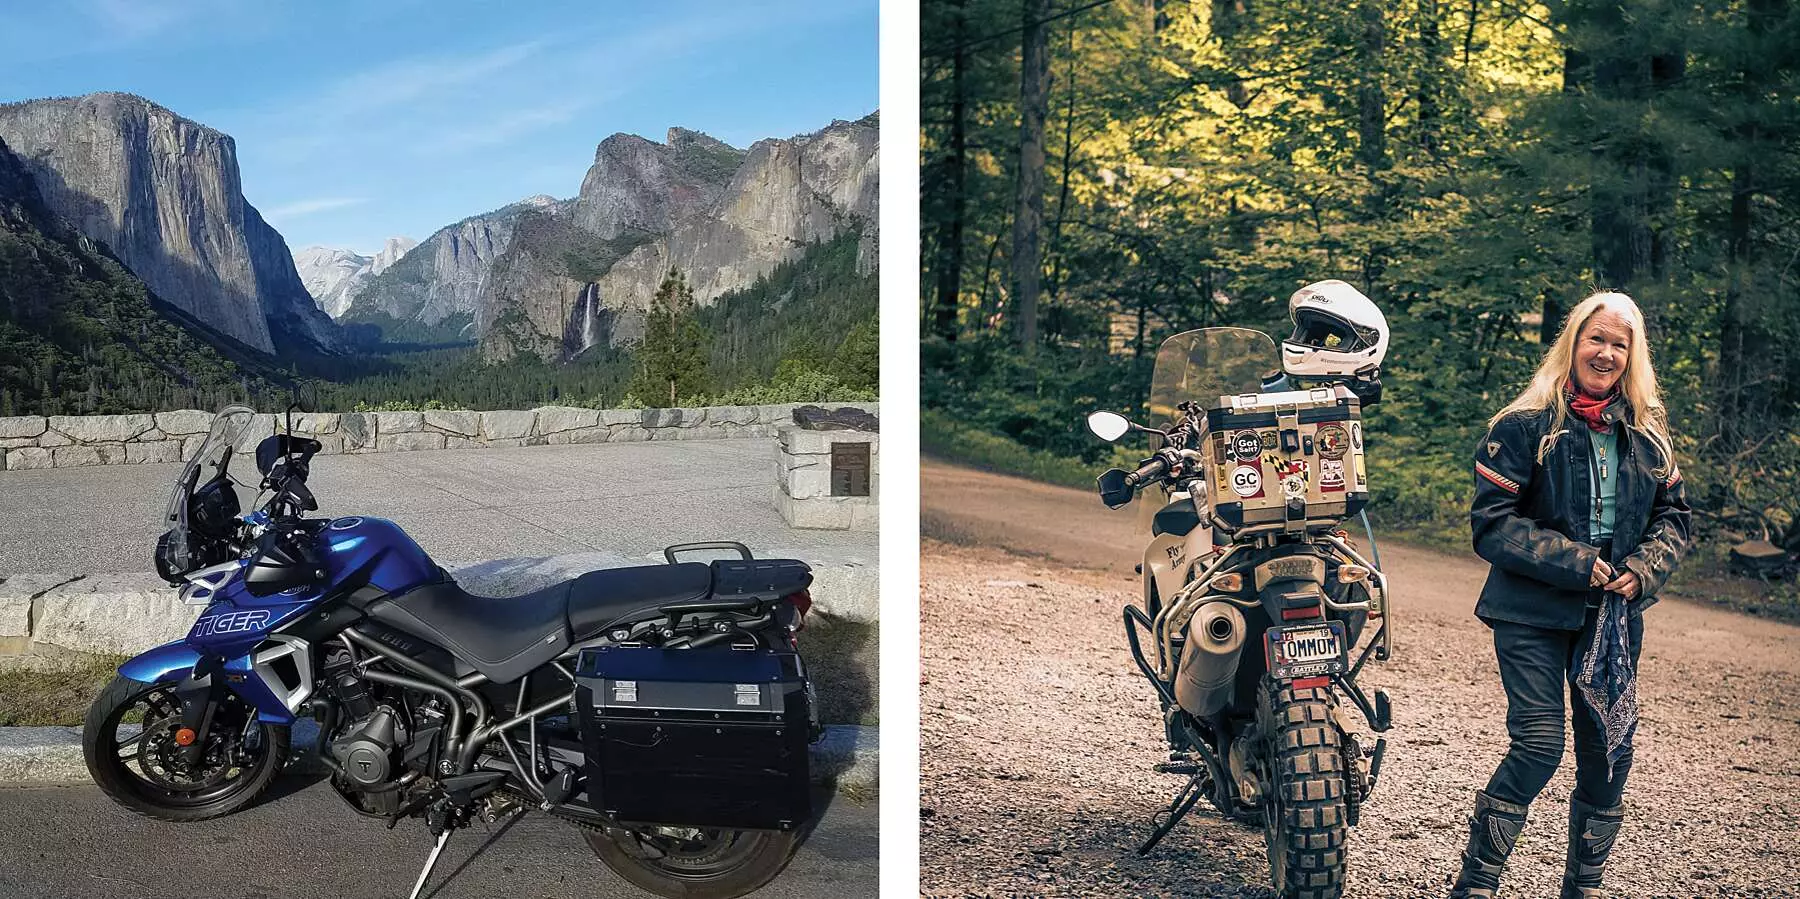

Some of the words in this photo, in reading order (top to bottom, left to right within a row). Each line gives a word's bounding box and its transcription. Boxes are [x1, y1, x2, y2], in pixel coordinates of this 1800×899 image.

[1238, 439, 1258, 447] Got
[1234, 472, 1257, 486] GC
[195, 609, 271, 638] TIGER
[1282, 632, 1292, 640] 12
[1321, 629, 1329, 637] 19
